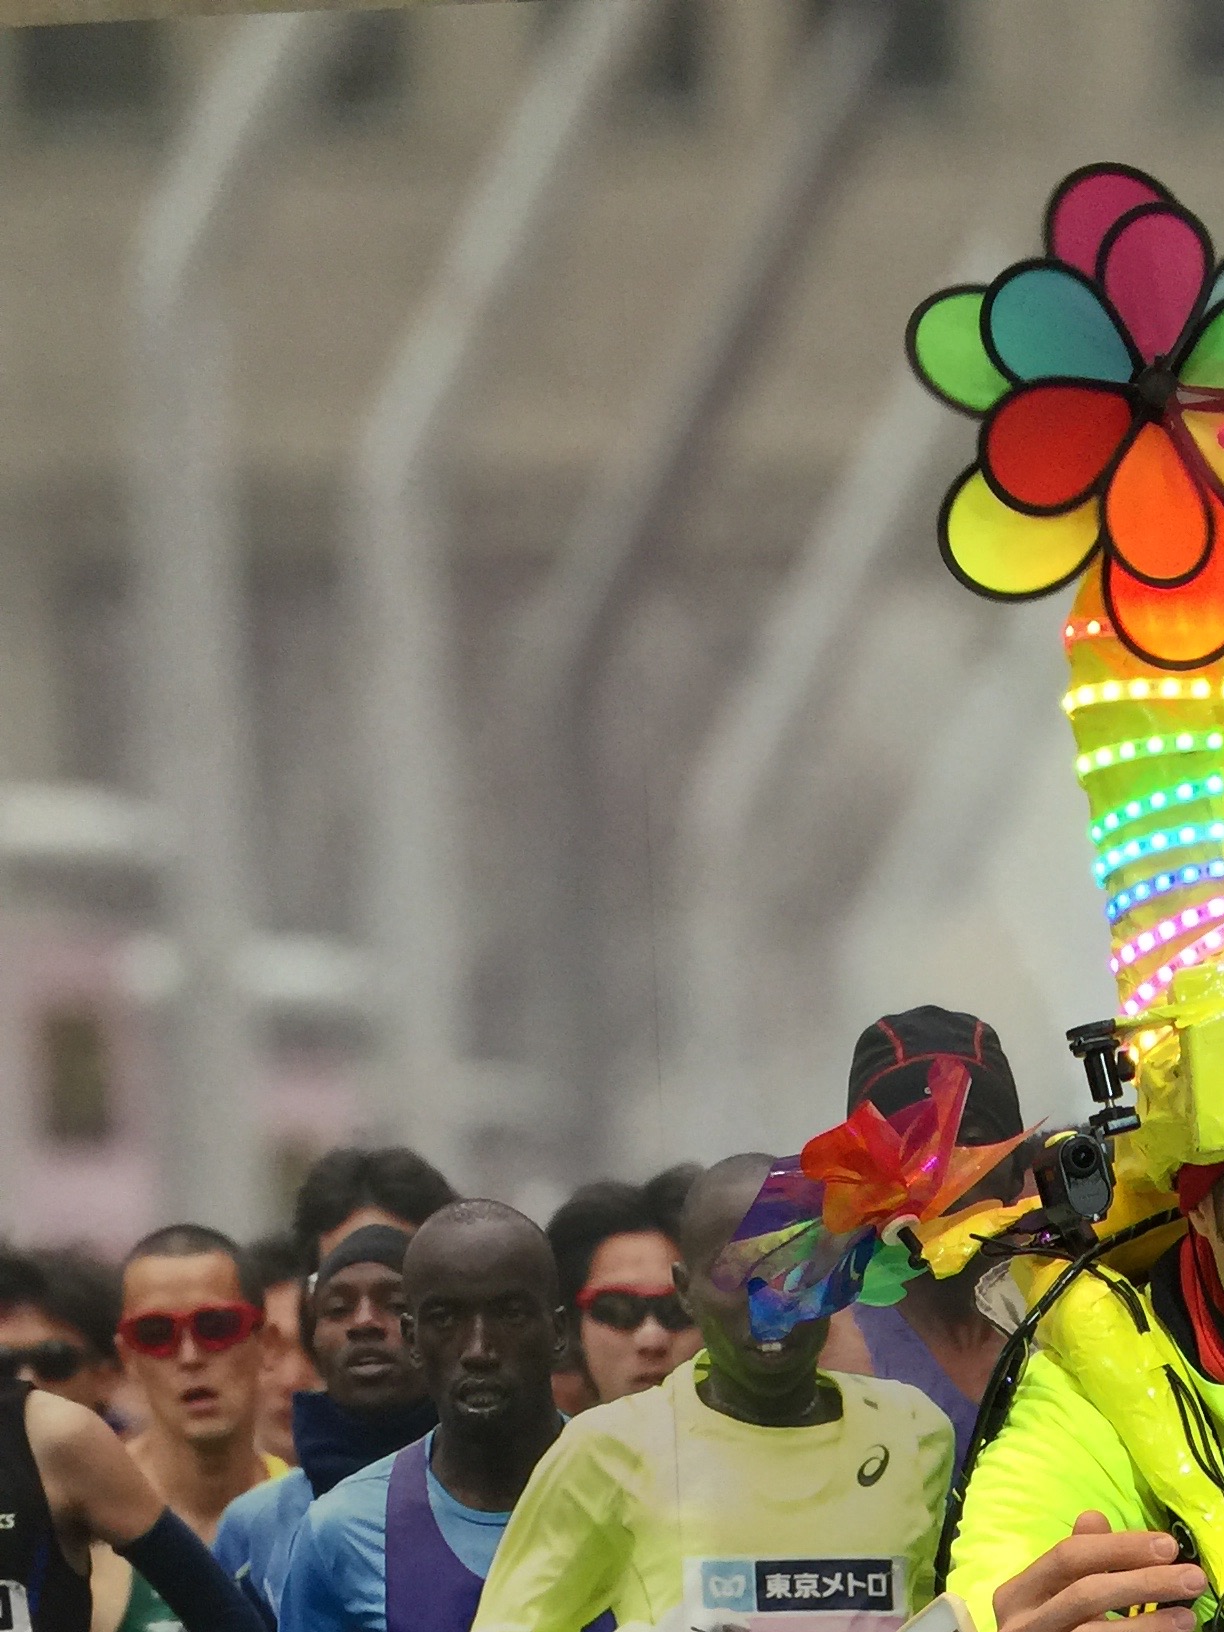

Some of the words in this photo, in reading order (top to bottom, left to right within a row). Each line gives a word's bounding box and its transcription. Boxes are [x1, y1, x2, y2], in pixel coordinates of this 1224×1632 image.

[764, 1572, 888, 1599] 東京メトロ
